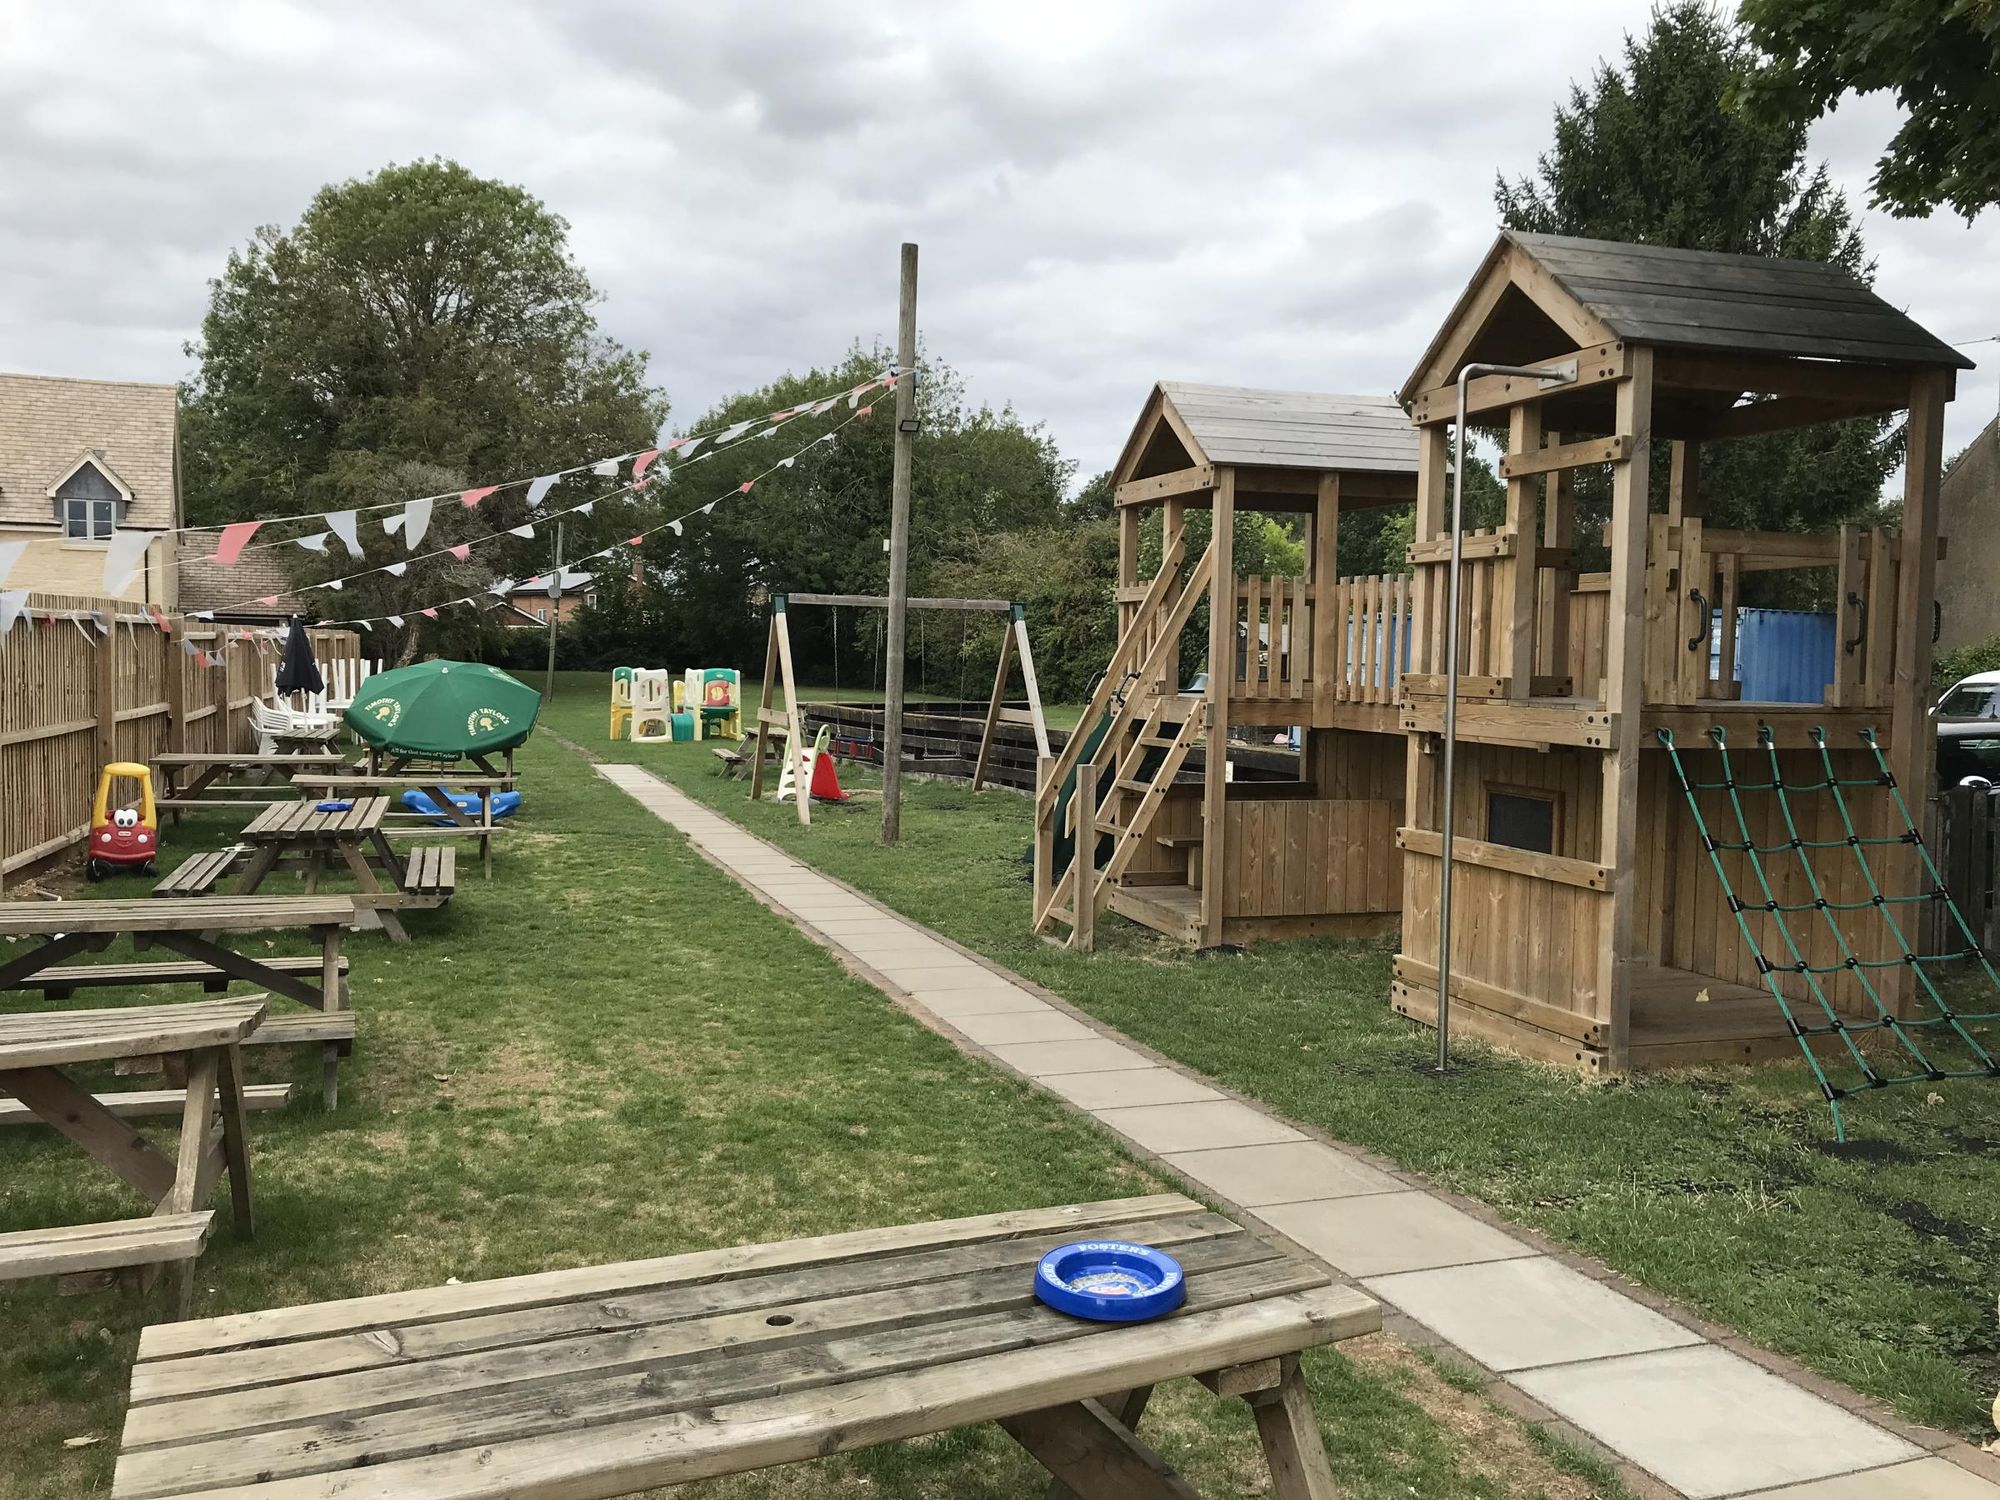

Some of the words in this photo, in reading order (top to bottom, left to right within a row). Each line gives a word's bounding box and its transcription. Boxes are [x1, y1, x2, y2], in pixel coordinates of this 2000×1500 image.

[365, 698, 395, 711] TIMOTHY
[467, 710, 479, 736] TIMOTHY
[479, 708, 510, 724] TAYLOR'S
[1077, 1243, 1151, 1256] FOSTER'S
